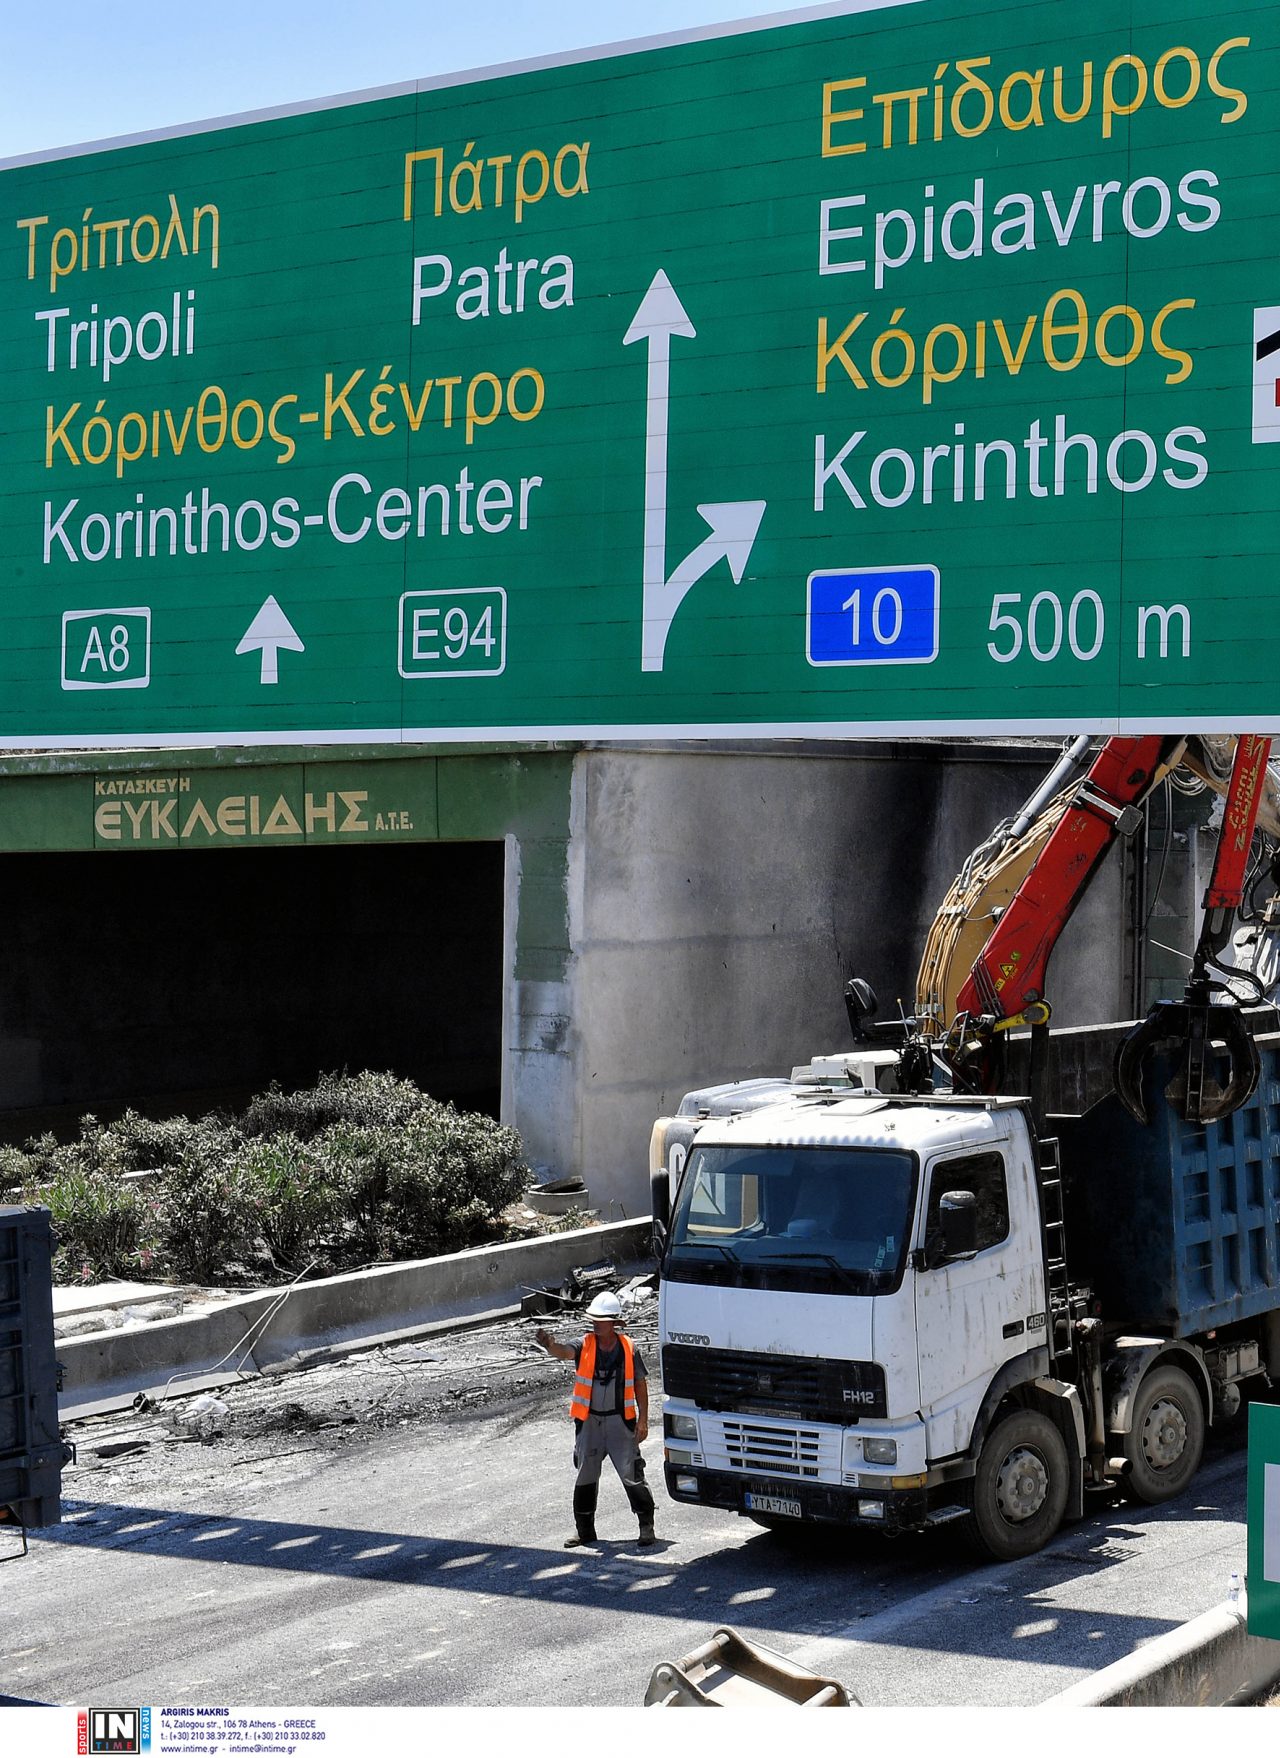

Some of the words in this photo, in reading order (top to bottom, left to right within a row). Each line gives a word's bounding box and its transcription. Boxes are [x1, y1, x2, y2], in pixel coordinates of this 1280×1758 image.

[820, 36, 1251, 158] Επίδαυρος
[403, 141, 590, 223] Πάτρα
[16, 194, 220, 293] Τρίπολη
[818, 169, 1221, 290] Epidavros
[412, 246, 574, 326] Patra
[34, 289, 195, 383] Tripoli
[815, 288, 1196, 405] Κόρινθος
[44, 364, 545, 479] Κόρινθος-Κέντρο
[813, 414, 1209, 512] Korinthos
[42, 465, 543, 565] Korinthos-Center
[80, 624, 131, 673] A8
[411, 605, 497, 660] E94
[842, 586, 904, 646] 10
[987, 589, 1106, 662] 500
[1136, 603, 1191, 659] m
[95, 777, 191, 796] ΚΑΤΑΣΚΕΥΗ
[95, 790, 369, 840] ΕΥΚΛΕΙΔΗΣ
[375, 811, 414, 831] Α.Τ.Ε.
[667, 1331, 711, 1346] VOLVO
[1028, 1314, 1045, 1328] 460
[842, 1389, 875, 1405] FH12
